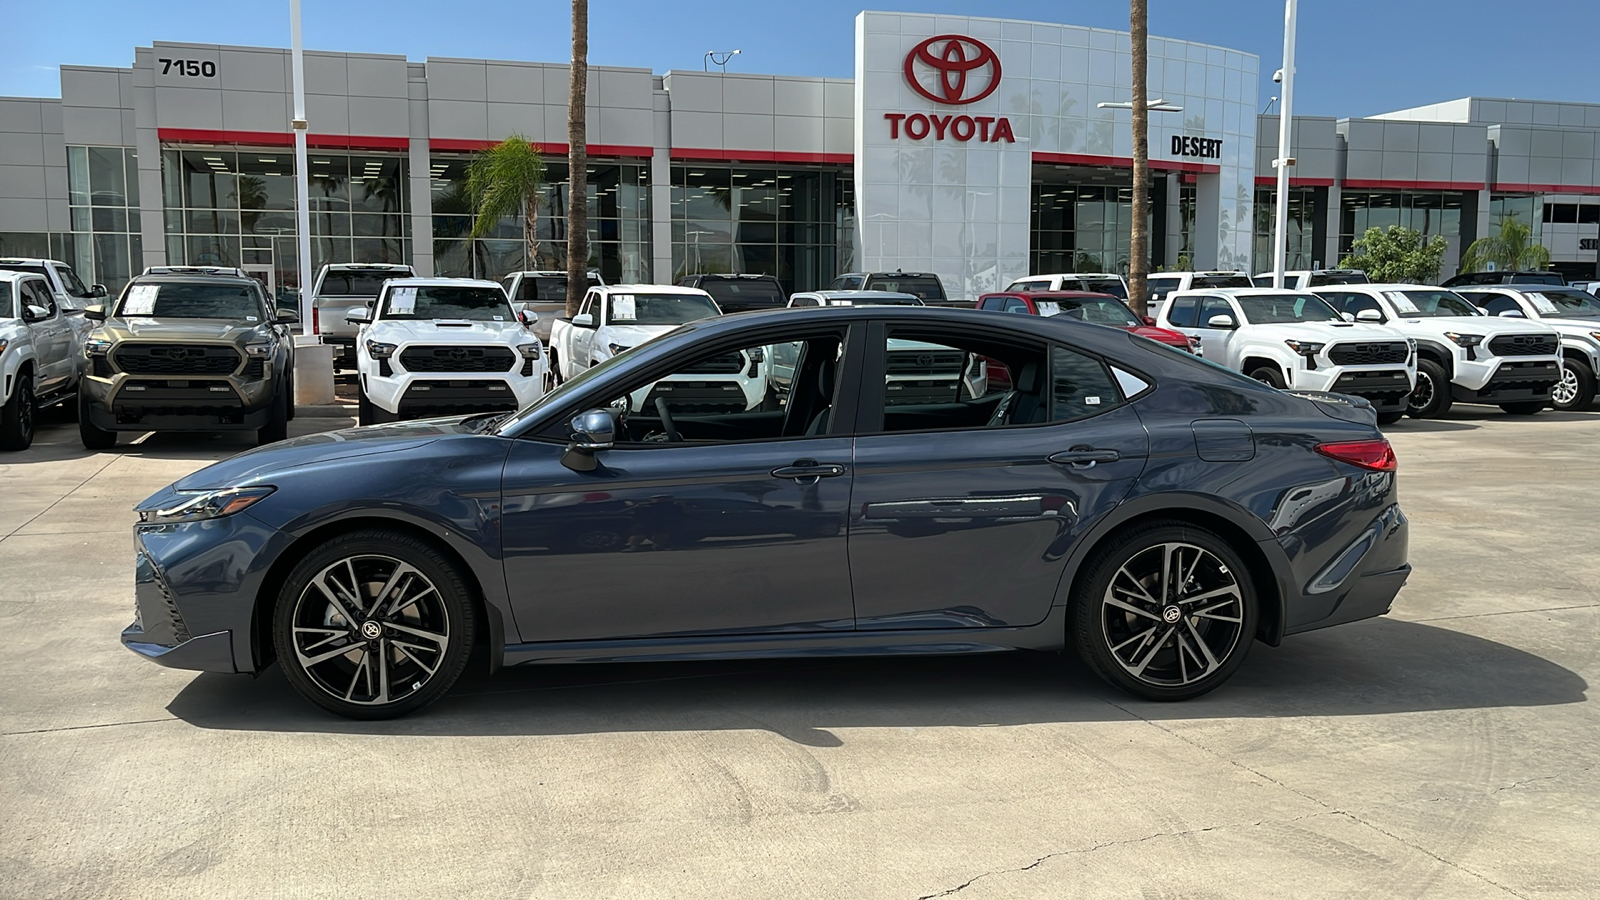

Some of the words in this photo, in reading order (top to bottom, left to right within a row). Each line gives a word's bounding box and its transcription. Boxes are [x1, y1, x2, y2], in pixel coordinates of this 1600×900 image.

[159, 58, 216, 78] 7150
[884, 113, 1015, 143] TOYOTA
[1171, 135, 1223, 159] DESERT
